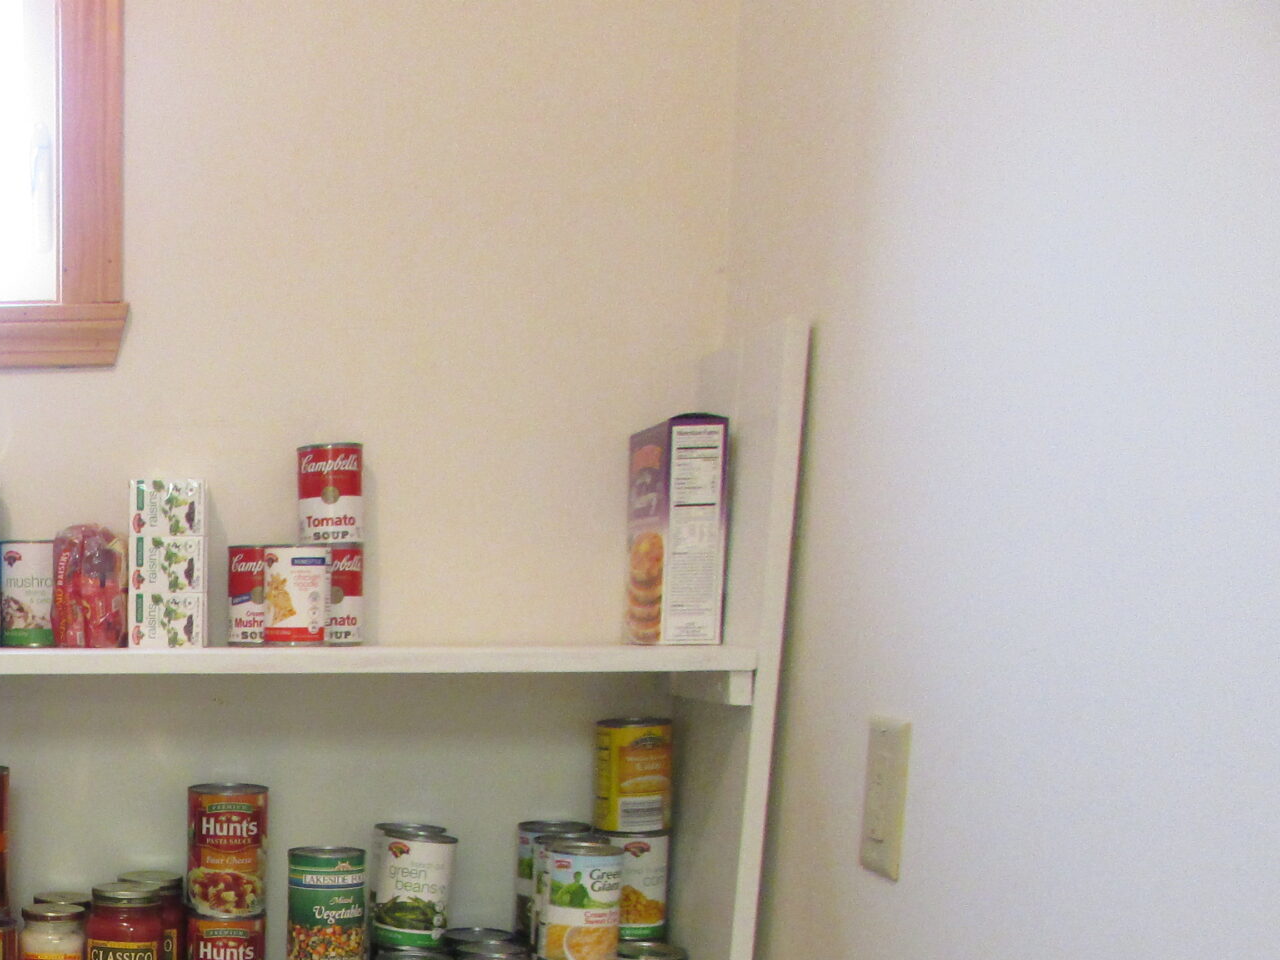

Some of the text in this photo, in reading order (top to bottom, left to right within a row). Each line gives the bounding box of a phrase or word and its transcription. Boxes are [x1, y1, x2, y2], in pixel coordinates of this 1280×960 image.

[307, 515, 356, 528] Tomato
[313, 531, 349, 540] SOUP
[201, 816, 258, 837] Hunt's
[389, 864, 427, 879] green
[589, 869, 619, 880] Gree
[304, 875, 346, 884] LAKESIDE
[395, 879, 437, 893] beans
